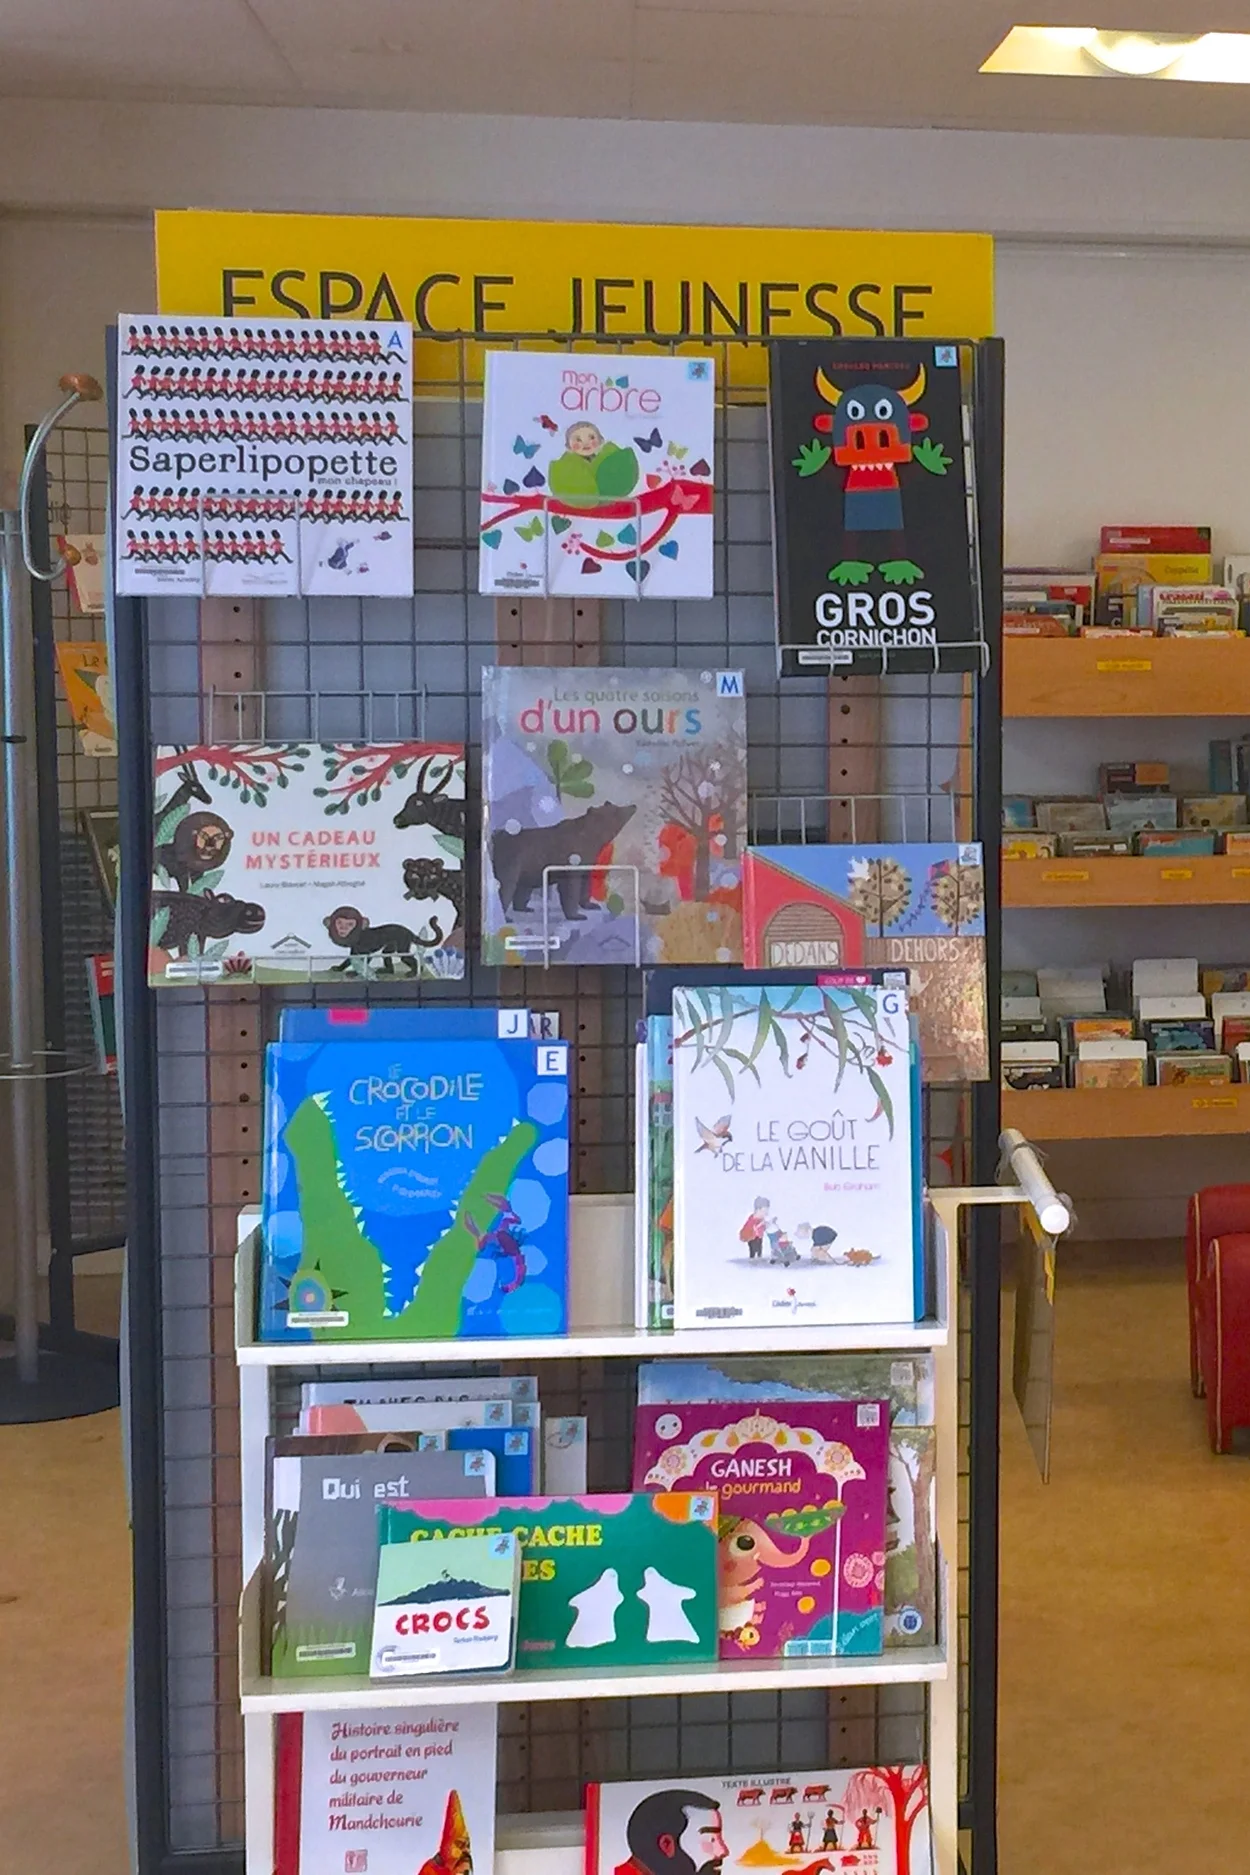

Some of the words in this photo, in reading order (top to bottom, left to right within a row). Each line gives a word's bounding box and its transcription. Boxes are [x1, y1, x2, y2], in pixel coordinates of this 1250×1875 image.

[222, 268, 514, 334] ESPACE
[547, 277, 933, 346] JEUNESSE
[387, 336, 403, 350] A
[561, 382, 661, 413] arbre
[128, 445, 398, 483] Saperlipopette
[345, 476, 392, 487] chapeau
[815, 591, 936, 628] GROS
[816, 627, 937, 646] CORNICHON
[720, 675, 740, 695] M
[553, 688, 580, 702] Les
[585, 688, 639, 705] quatre
[642, 688, 700, 703] saisons
[519, 698, 601, 735] d'un
[613, 707, 703, 735] ours
[251, 831, 280, 847] UN
[287, 829, 376, 847] CADEAU
[245, 849, 381, 870] MYSTÉRIEUX
[771, 941, 840, 966] DEDANS
[891, 937, 960, 963] DEHORS
[882, 993, 899, 1015] G
[506, 1014, 518, 1035] J
[541, 1016, 553, 1037] R
[546, 1051, 560, 1071] E
[757, 1120, 780, 1143] LE
[787, 1109, 859, 1142] GOÛT
[723, 1152, 745, 1173] DE
[750, 1151, 774, 1172] LA
[777, 1144, 881, 1171] VANILLE
[710, 1457, 792, 1479] GANESH
[322, 1477, 361, 1500] Qui
[373, 1474, 411, 1499] est
[721, 1477, 802, 1500] gourmand
[513, 1524, 603, 1548] CACHE
[395, 1605, 491, 1636] CROCS
[331, 1721, 392, 1740] Histoire
[394, 1716, 460, 1738] singulière
[330, 1745, 347, 1761] du
[350, 1744, 402, 1763] portrait
[405, 1746, 421, 1758] en
[424, 1739, 453, 1760] pied
[329, 1769, 347, 1785] du
[350, 1768, 428, 1787] gouverneur
[328, 1791, 384, 1808] militaire
[386, 1789, 404, 1805] de
[328, 1812, 424, 1832] Mandchourie
